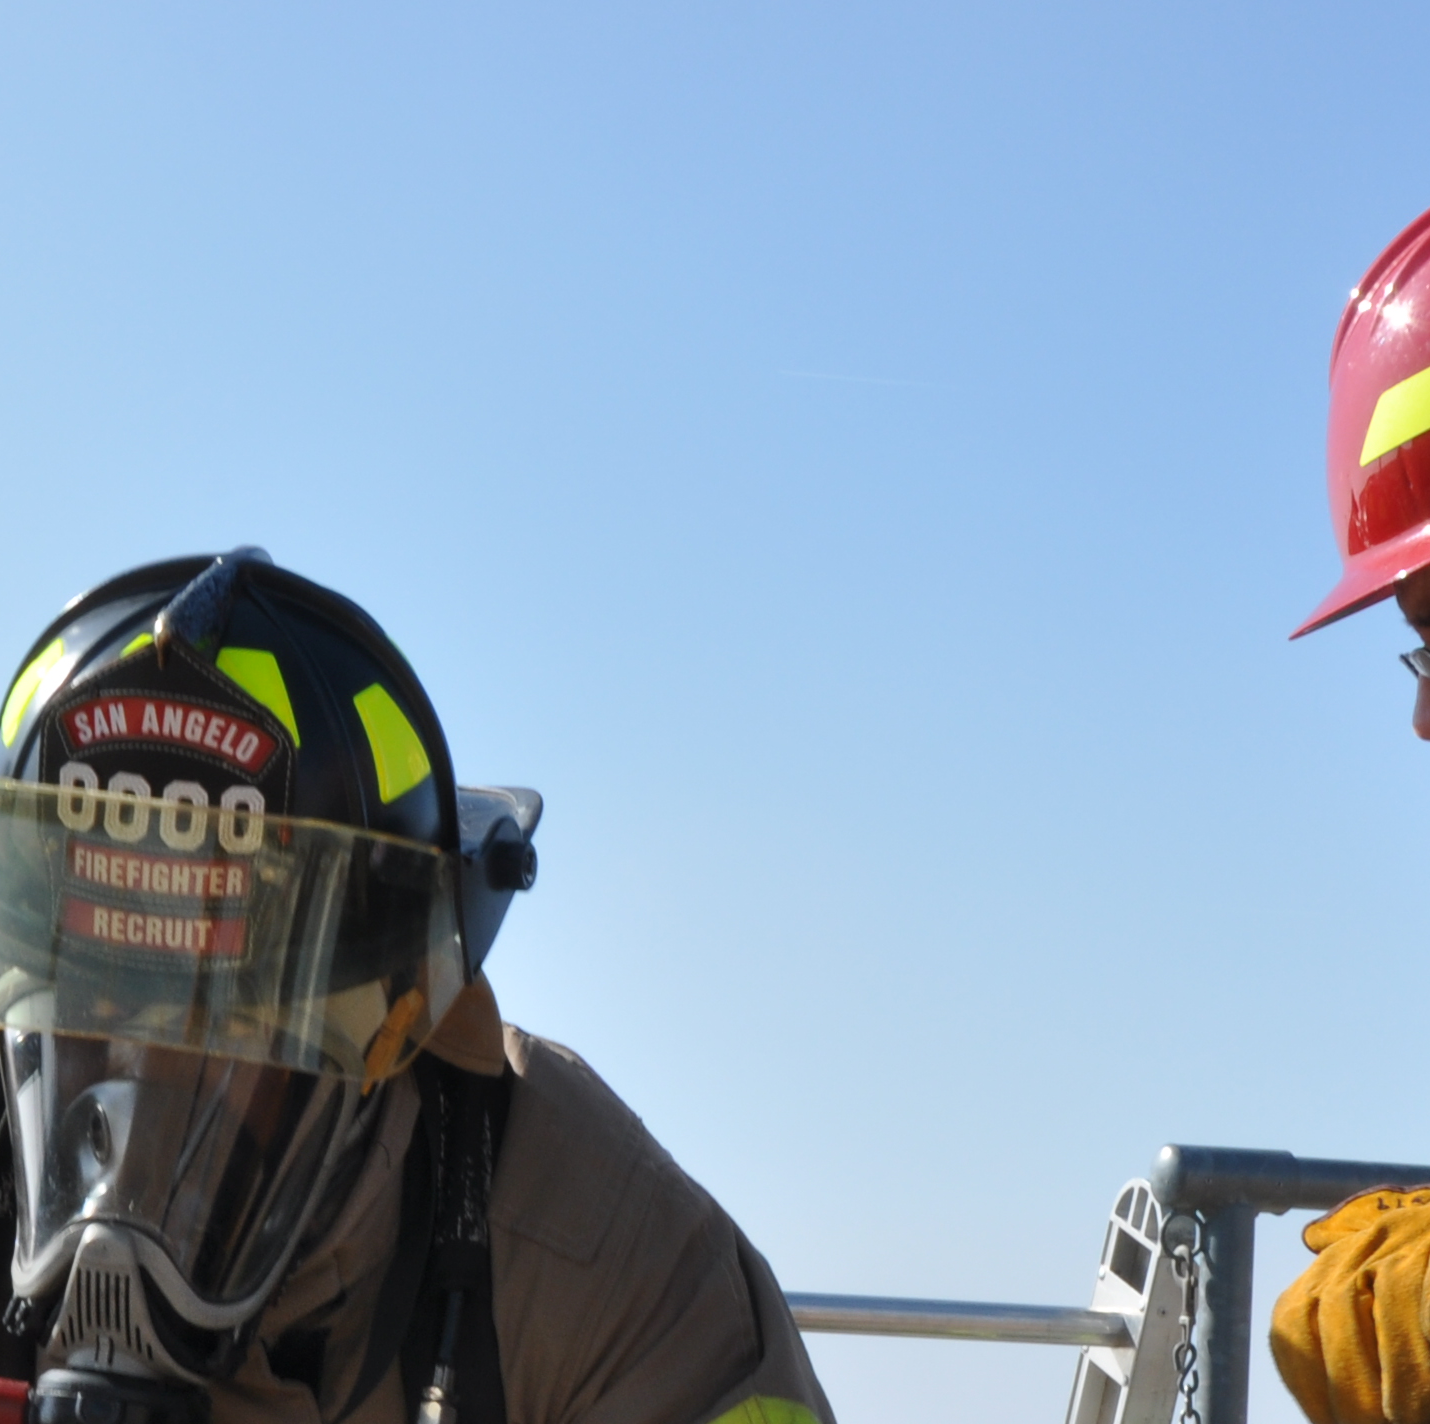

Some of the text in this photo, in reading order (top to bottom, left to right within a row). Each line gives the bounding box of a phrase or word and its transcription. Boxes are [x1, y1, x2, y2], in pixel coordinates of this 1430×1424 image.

[74, 703, 260, 763] SAN ANGELO
[57, 761, 266, 855] 0000
[74, 849, 244, 896] FIREFIGHTER
[93, 907, 213, 950] RECRUIT
